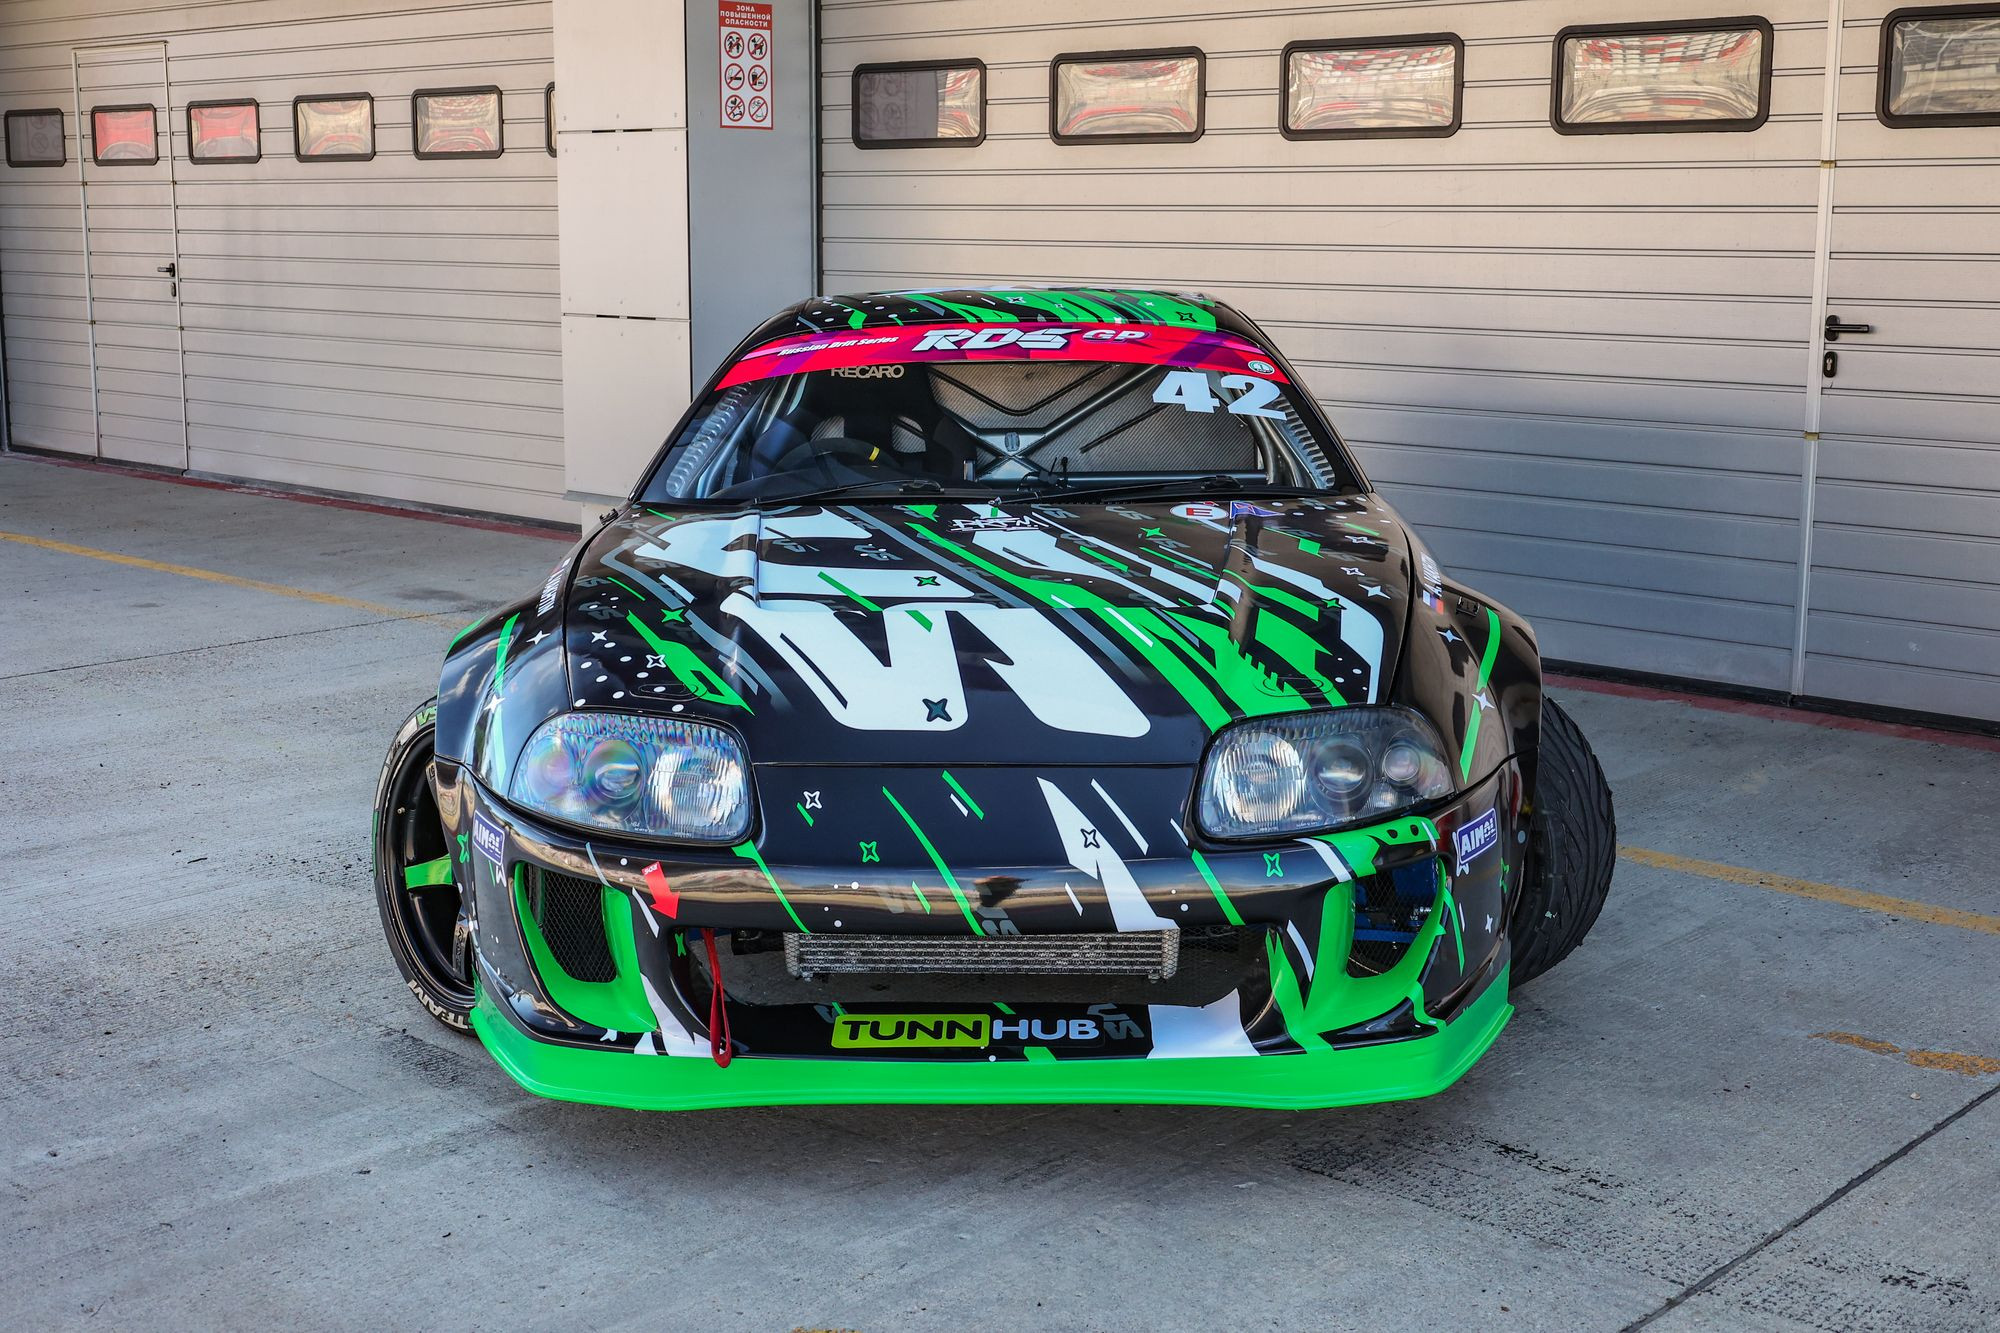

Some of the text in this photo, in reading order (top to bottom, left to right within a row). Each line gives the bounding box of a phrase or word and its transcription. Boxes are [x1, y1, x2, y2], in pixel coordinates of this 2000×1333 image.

[720, 10, 771, 20] ПОВЫШЕННОЙ
[725, 18, 768, 27] ОПАСНОСТИ
[777, 336, 899, 356] Russian Drift Series
[911, 328, 1147, 351] RDS GP
[831, 364, 905, 379] RECARO
[1152, 370, 1287, 420] 42
